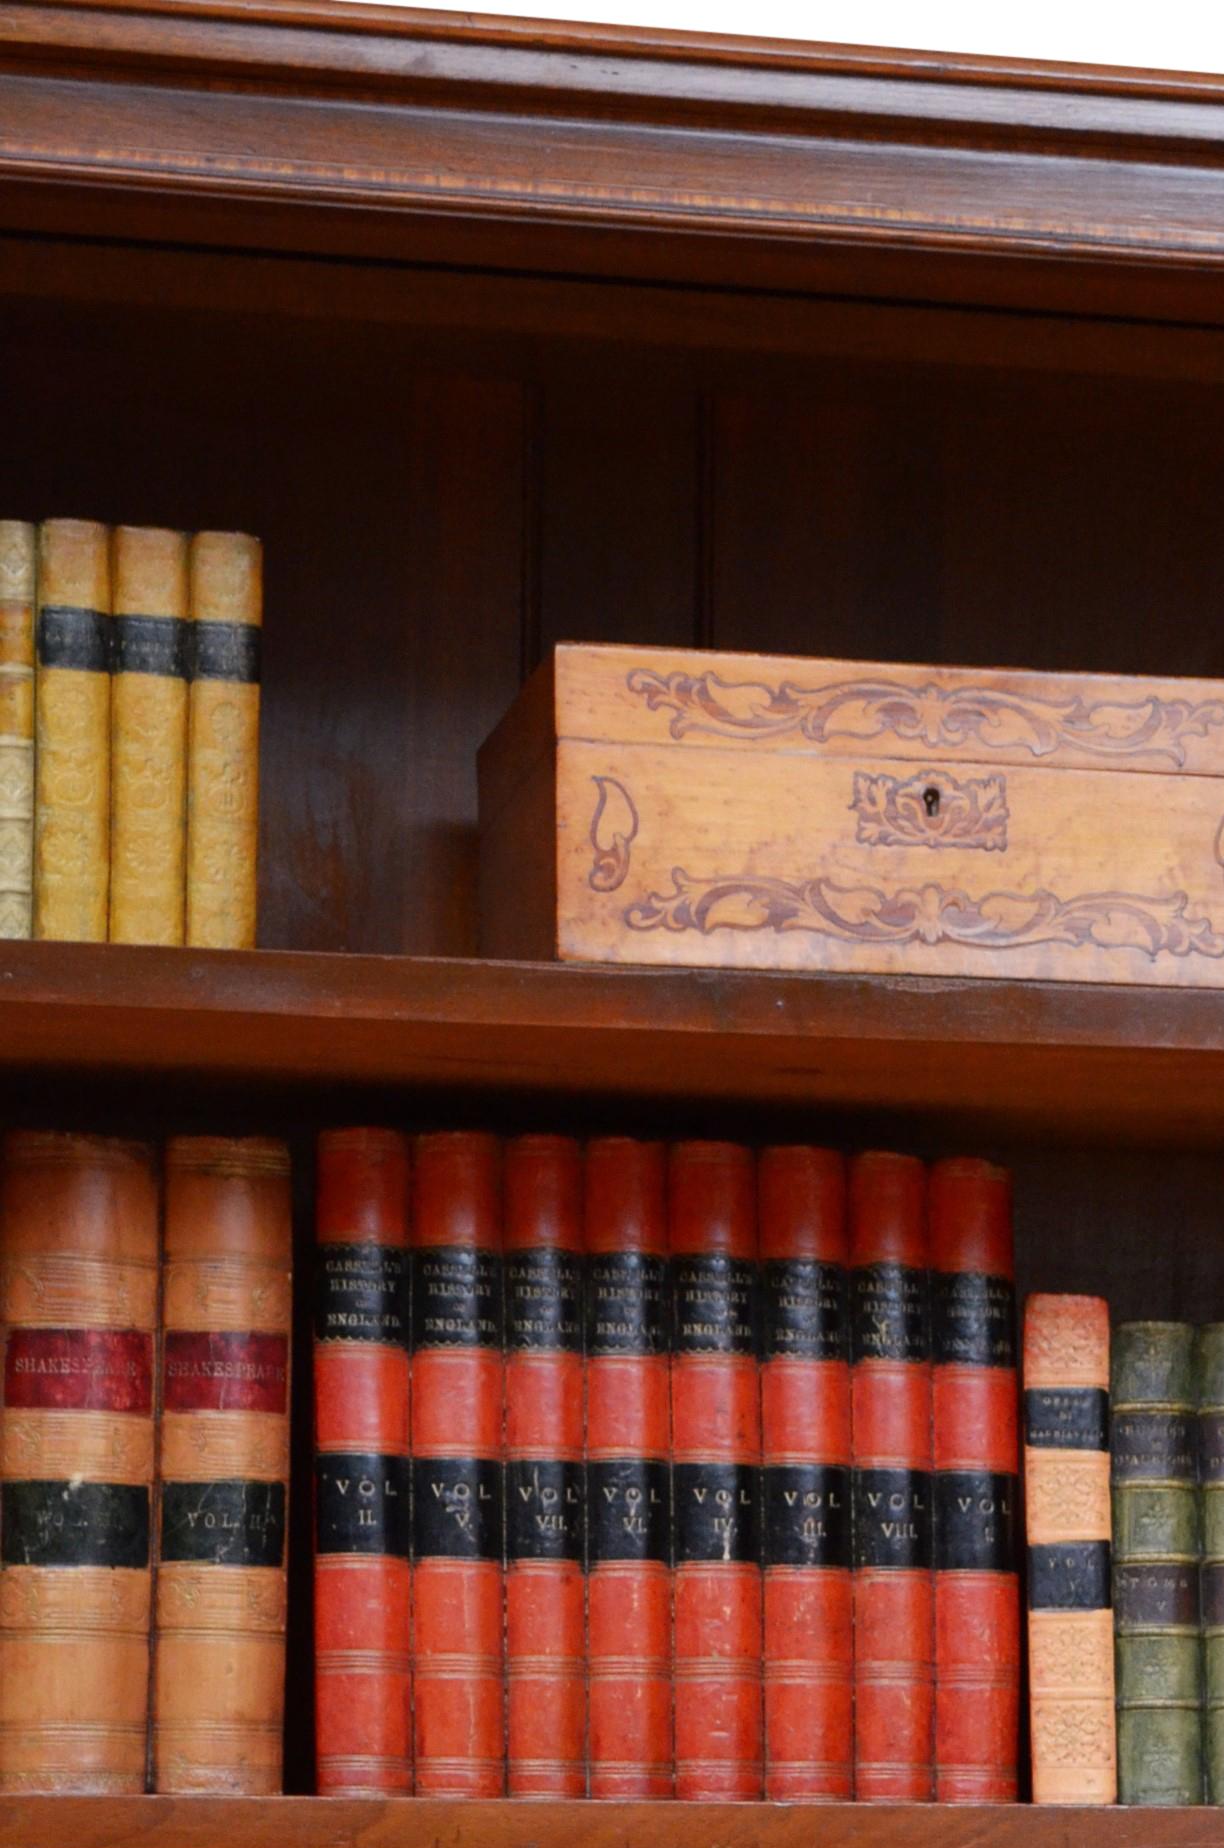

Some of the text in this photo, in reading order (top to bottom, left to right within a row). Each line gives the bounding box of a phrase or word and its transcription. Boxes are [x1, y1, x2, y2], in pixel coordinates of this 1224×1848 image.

[336, 1479, 398, 1498] VOL
[431, 1482, 492, 1499] VOL
[519, 1487, 577, 1503] VOL
[603, 1487, 661, 1503] VOL
[693, 1488, 751, 1505] VOL
[783, 1491, 840, 1509] VOL
[868, 1493, 925, 1510] VOL
[958, 1497, 1011, 1514] VOL
